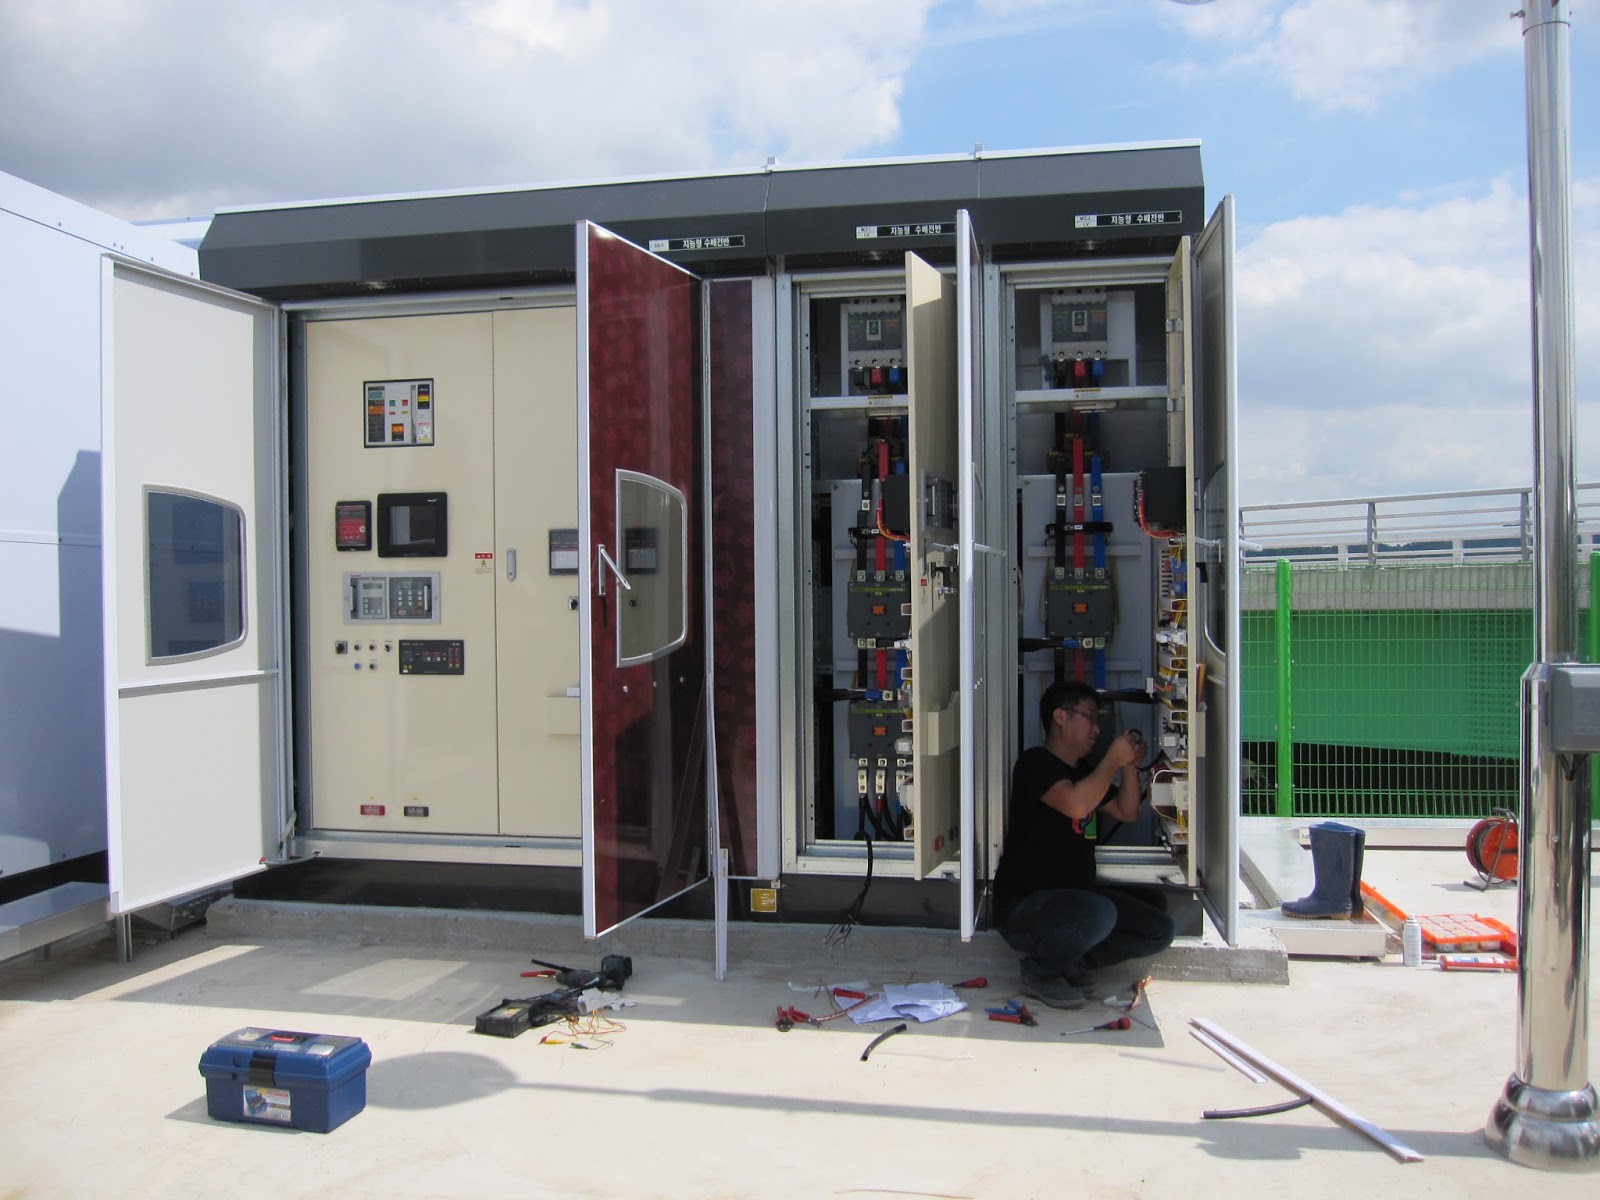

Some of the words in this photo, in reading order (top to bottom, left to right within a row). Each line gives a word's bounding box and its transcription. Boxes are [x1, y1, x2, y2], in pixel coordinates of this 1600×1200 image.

[1111, 215, 1131, 224] 지능형
[1137, 213, 1164, 223] 수배전반
[891, 226, 910, 235] 지능형
[915, 224, 941, 234] 수배전반
[683, 239, 702, 248] 지능형
